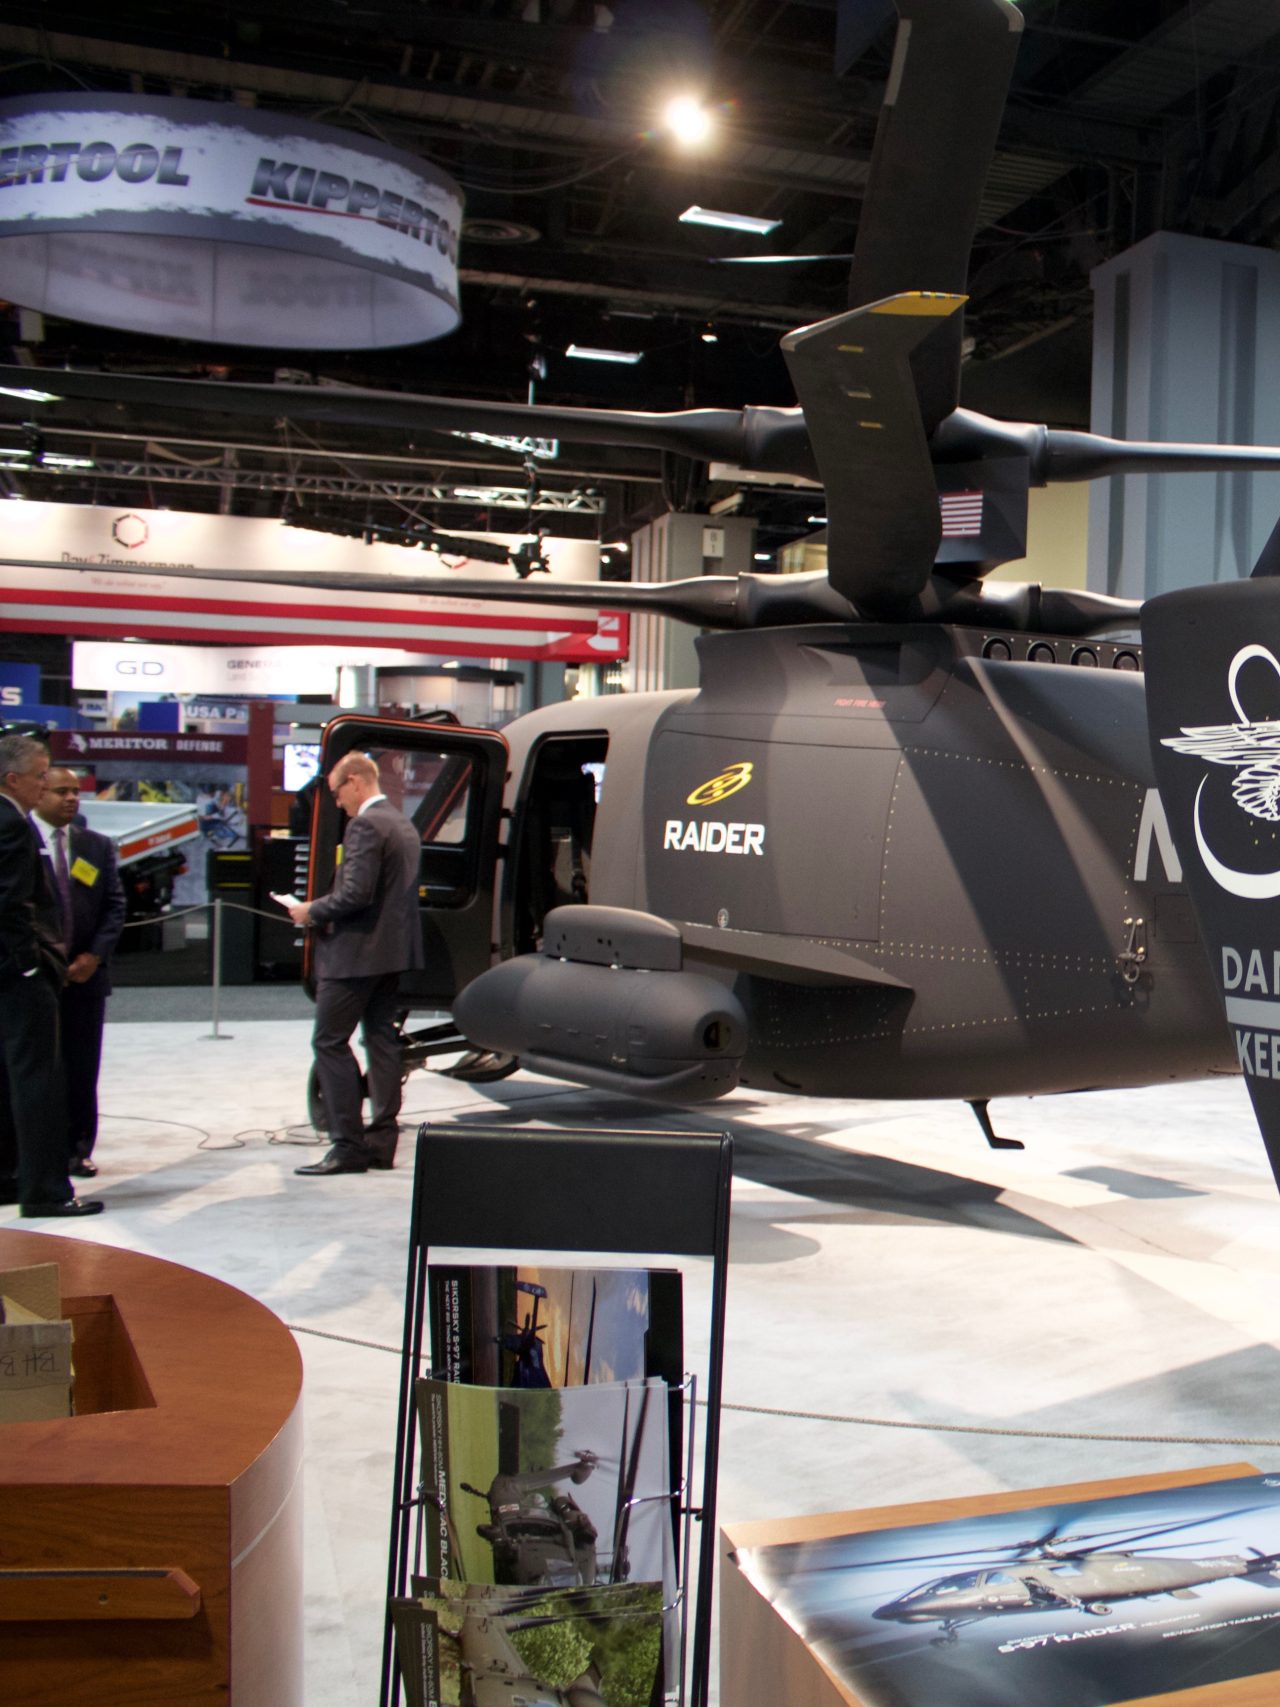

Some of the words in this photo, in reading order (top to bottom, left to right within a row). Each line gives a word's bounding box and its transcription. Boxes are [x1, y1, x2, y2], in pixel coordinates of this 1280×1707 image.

[116, 660, 165, 676] GD
[89, 737, 168, 751] MERITOR
[176, 739, 223, 753] DEFENSE
[664, 820, 765, 856] RAIDER
[451, 1280, 459, 1333] SIKORSKY
[1053, 1622, 1137, 1643] RAIDER
